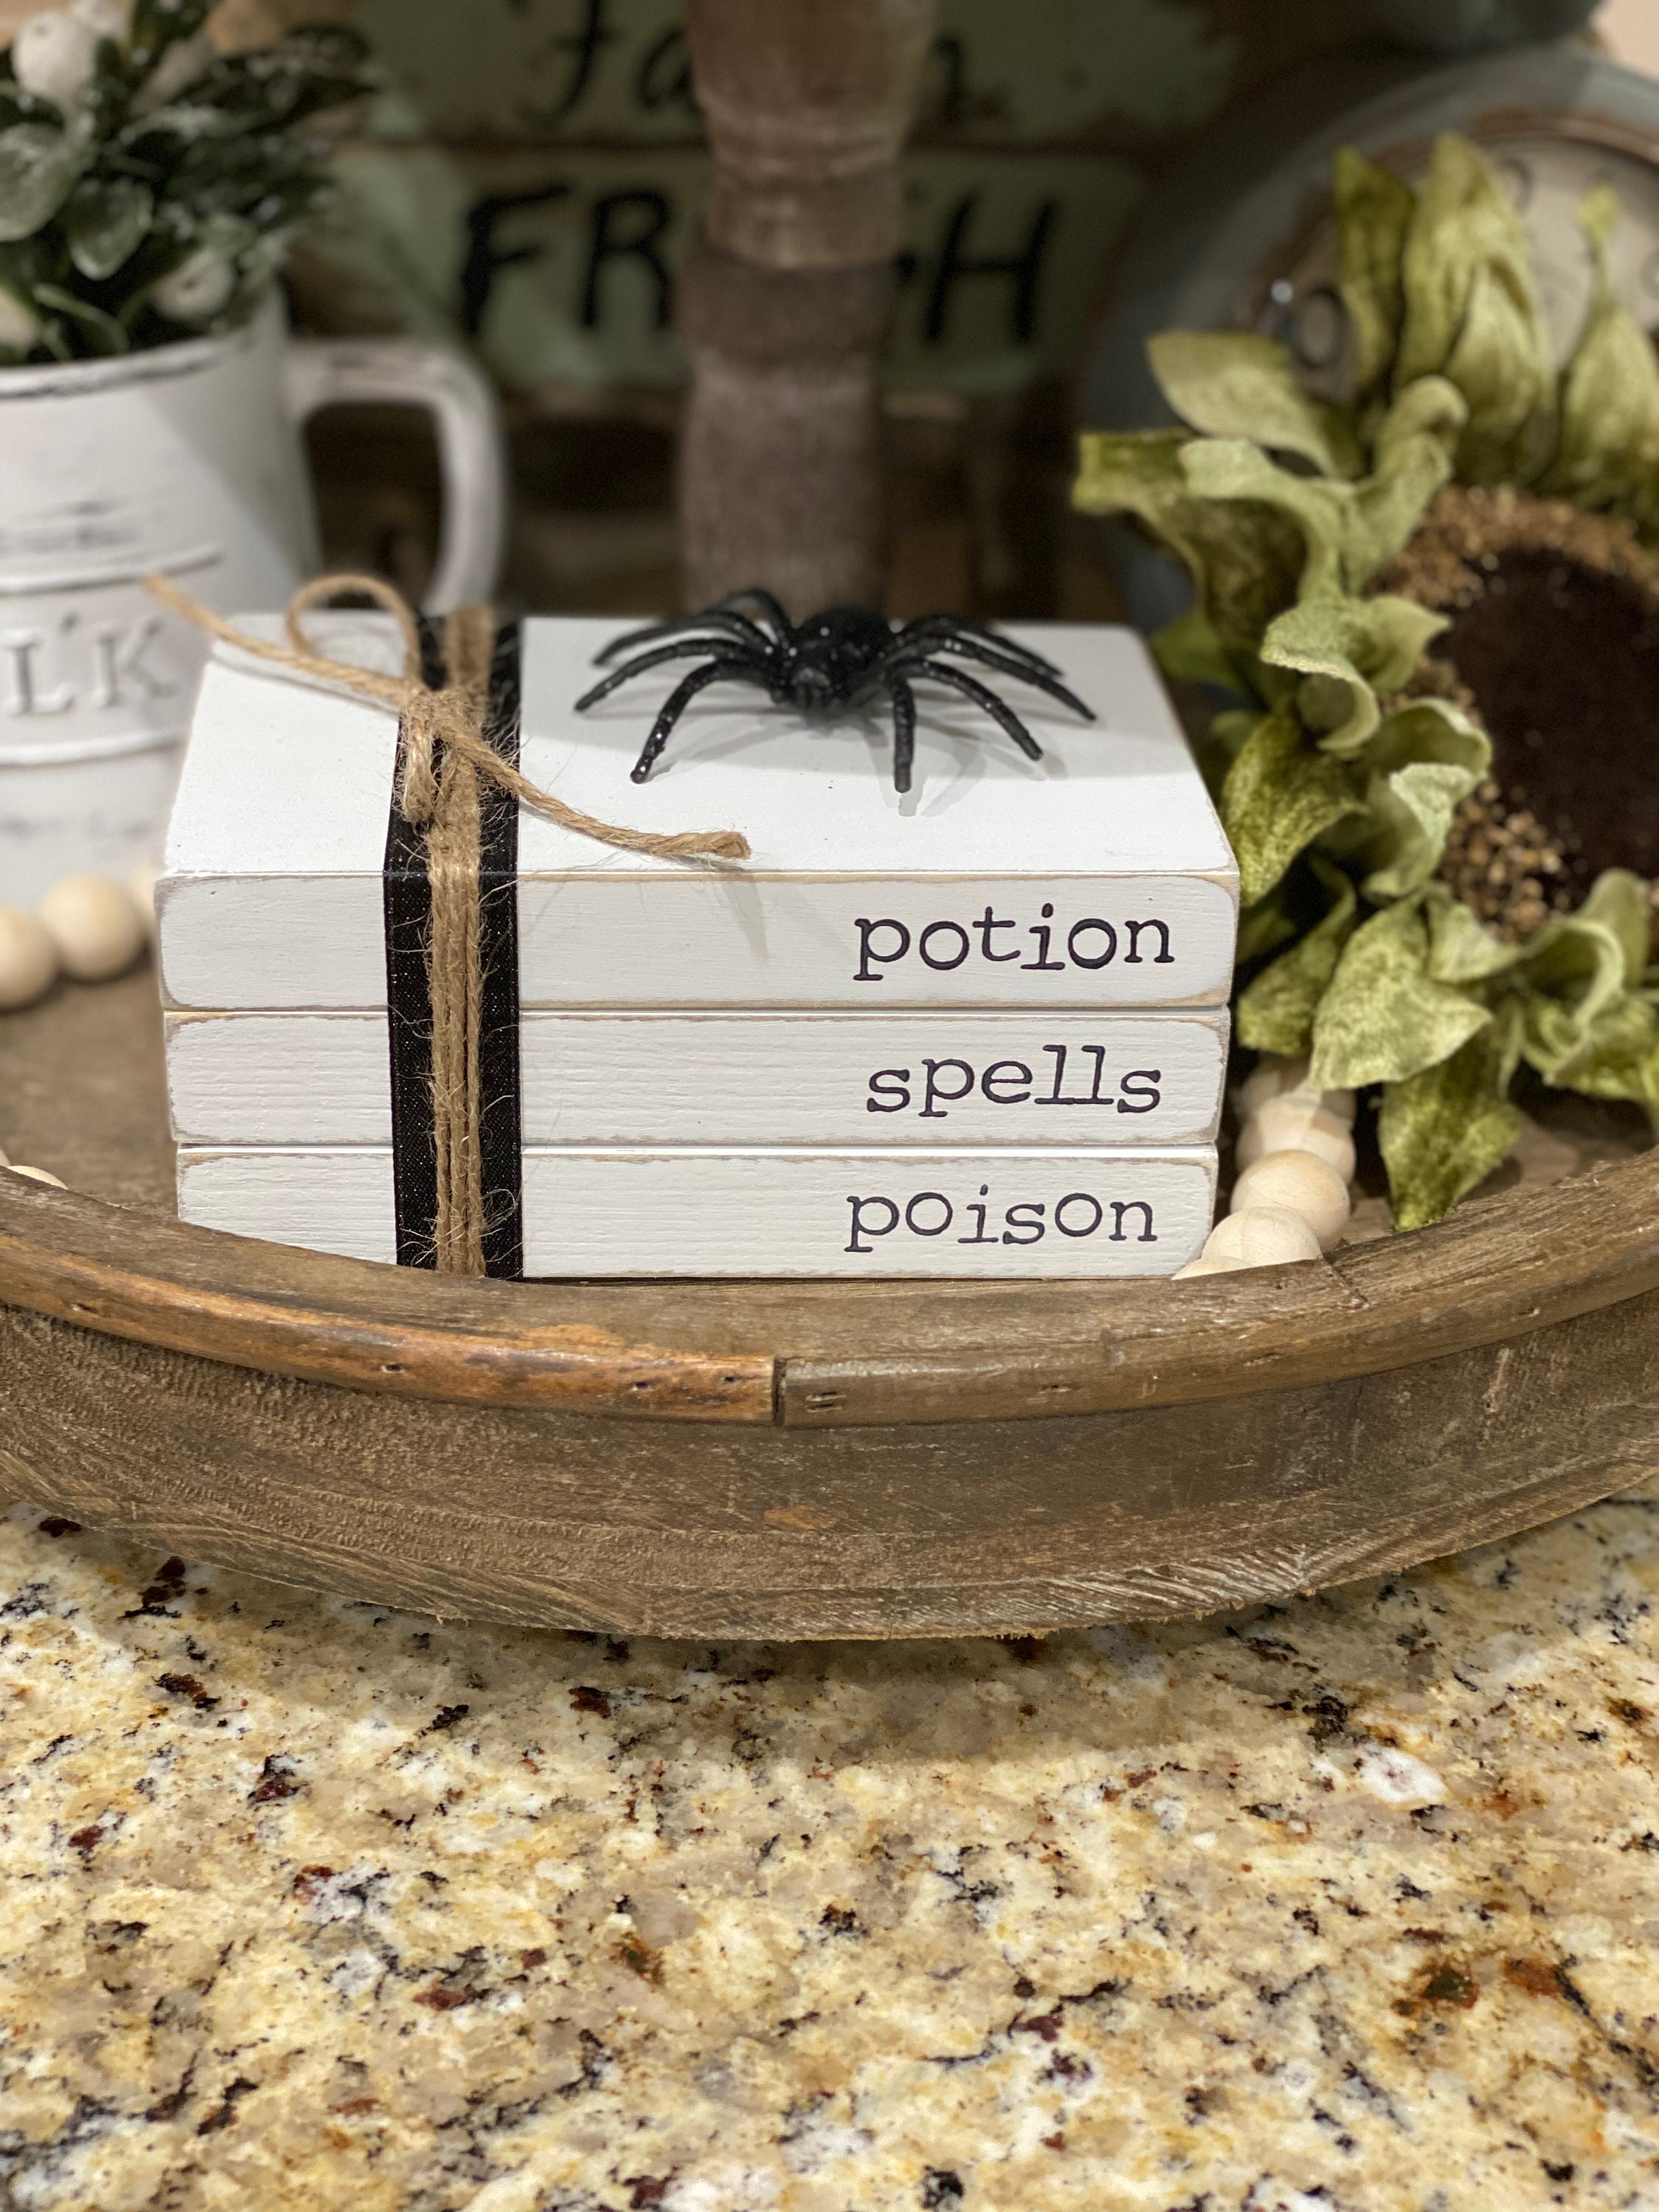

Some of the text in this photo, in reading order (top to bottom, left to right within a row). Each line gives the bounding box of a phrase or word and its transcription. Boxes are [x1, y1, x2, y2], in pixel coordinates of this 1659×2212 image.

[457, 180, 1059, 344] FRH
[852, 902, 1175, 981] potion
[866, 1044, 1162, 1118] spells
[844, 1184, 1158, 1253] poison
